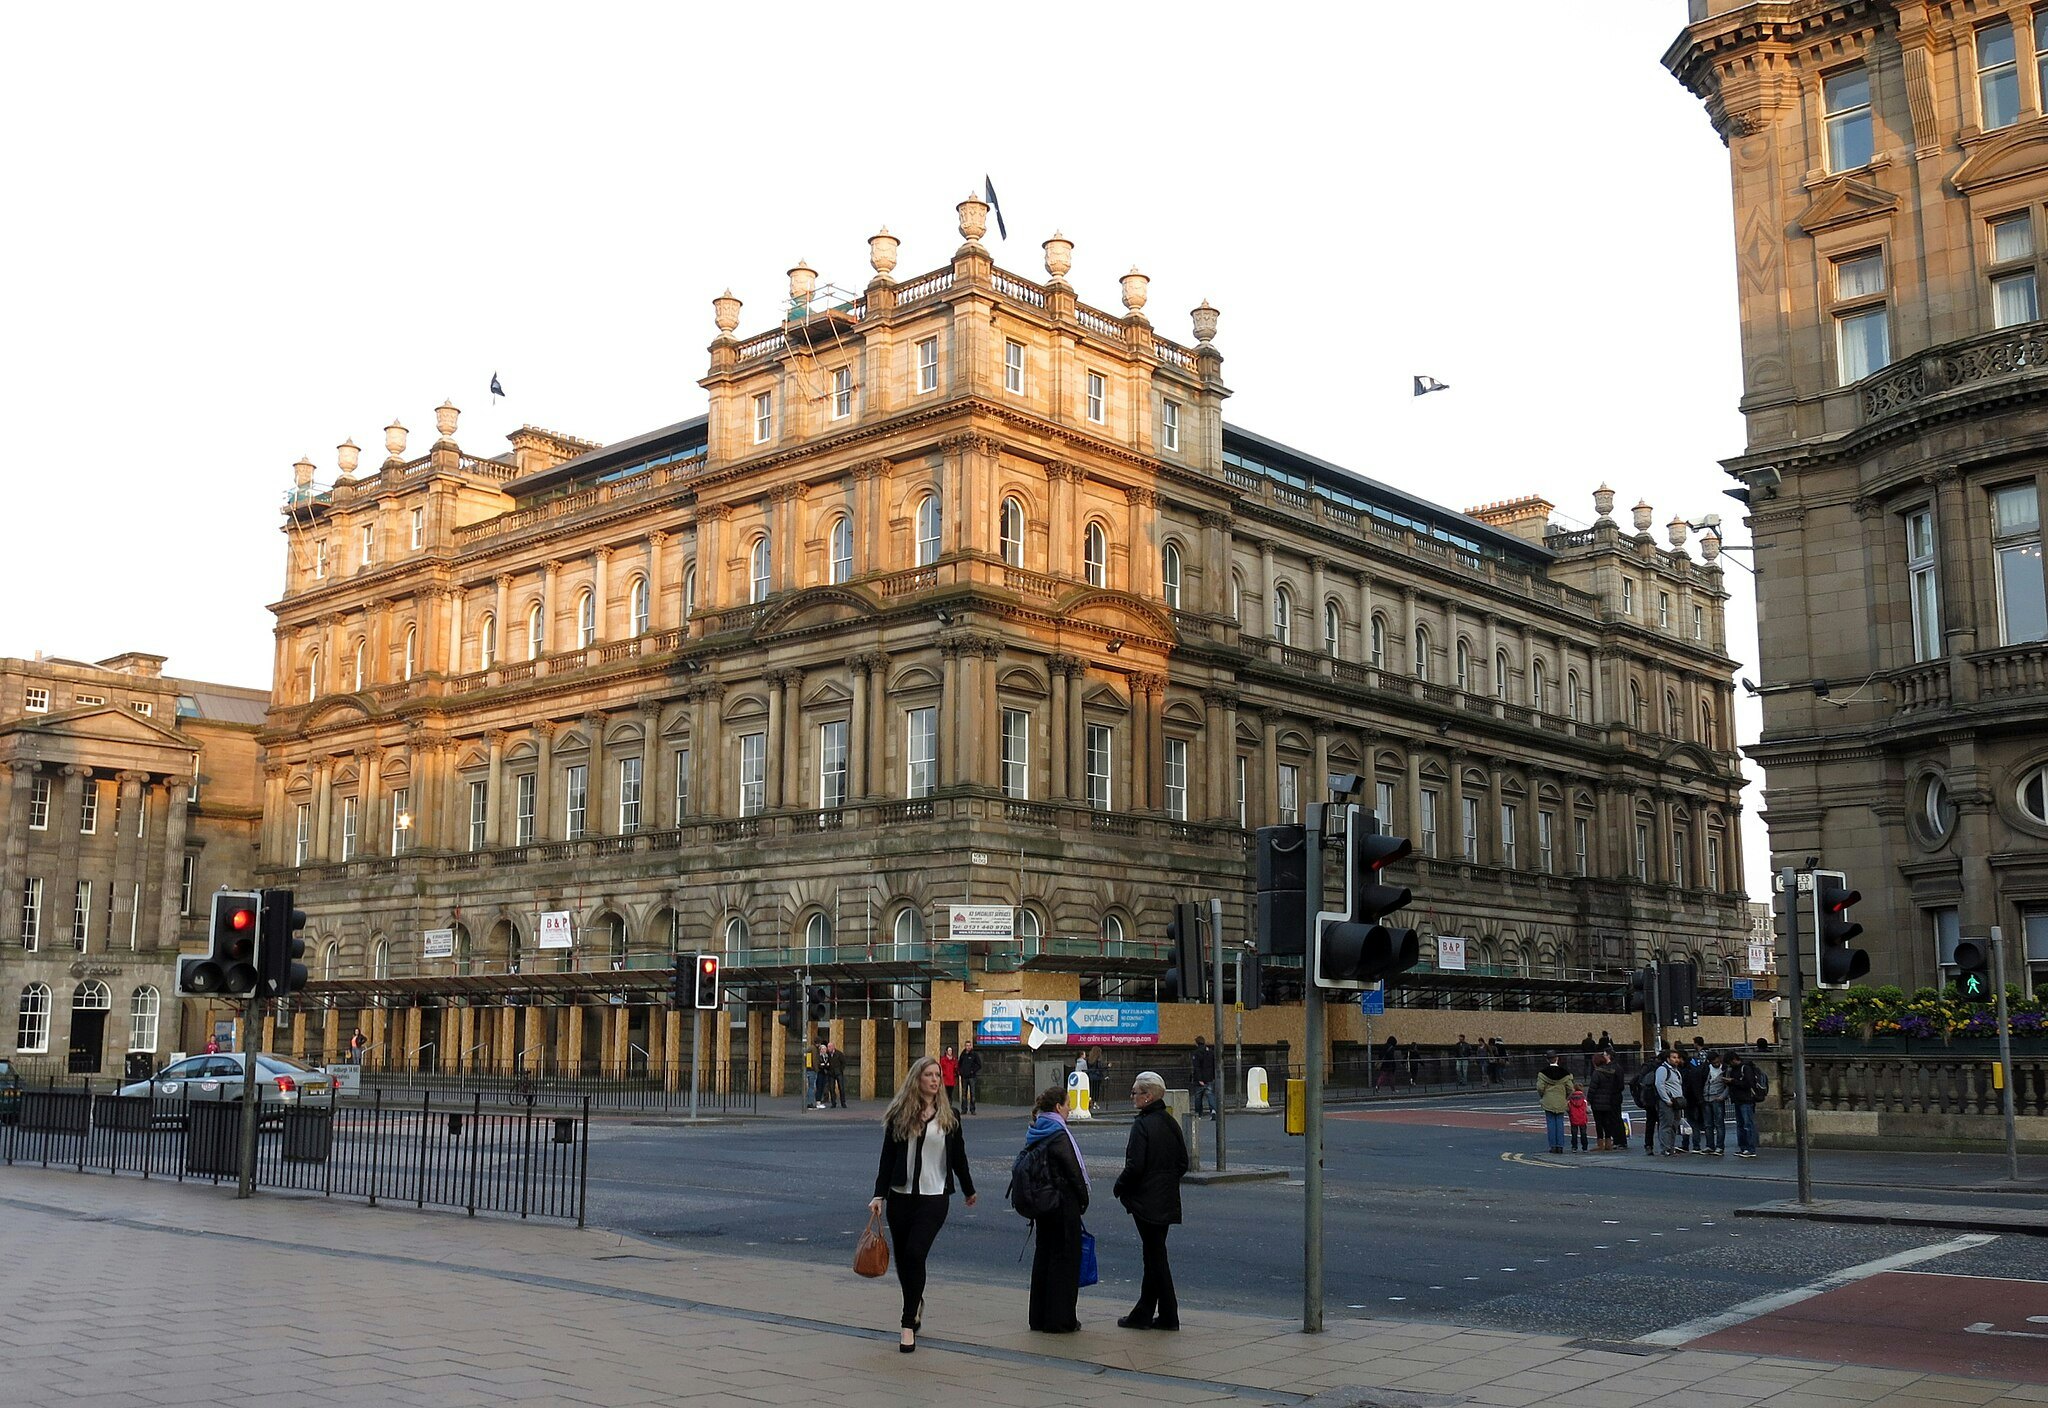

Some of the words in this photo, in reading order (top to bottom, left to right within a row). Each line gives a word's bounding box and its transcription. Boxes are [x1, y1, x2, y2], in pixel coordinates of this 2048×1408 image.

[547, 919, 552, 928] B
[554, 918, 559, 928] &
[562, 917, 567, 927] P
[1443, 942, 1448, 951] B
[1449, 942, 1454, 951] &
[1456, 943, 1460, 951] P
[992, 1006, 1007, 1015] gym
[1025, 1005, 1034, 1014] the
[1084, 1014, 1114, 1022] ENTRANCE
[1112, 1035, 1151, 1043] thegymgroup.com
